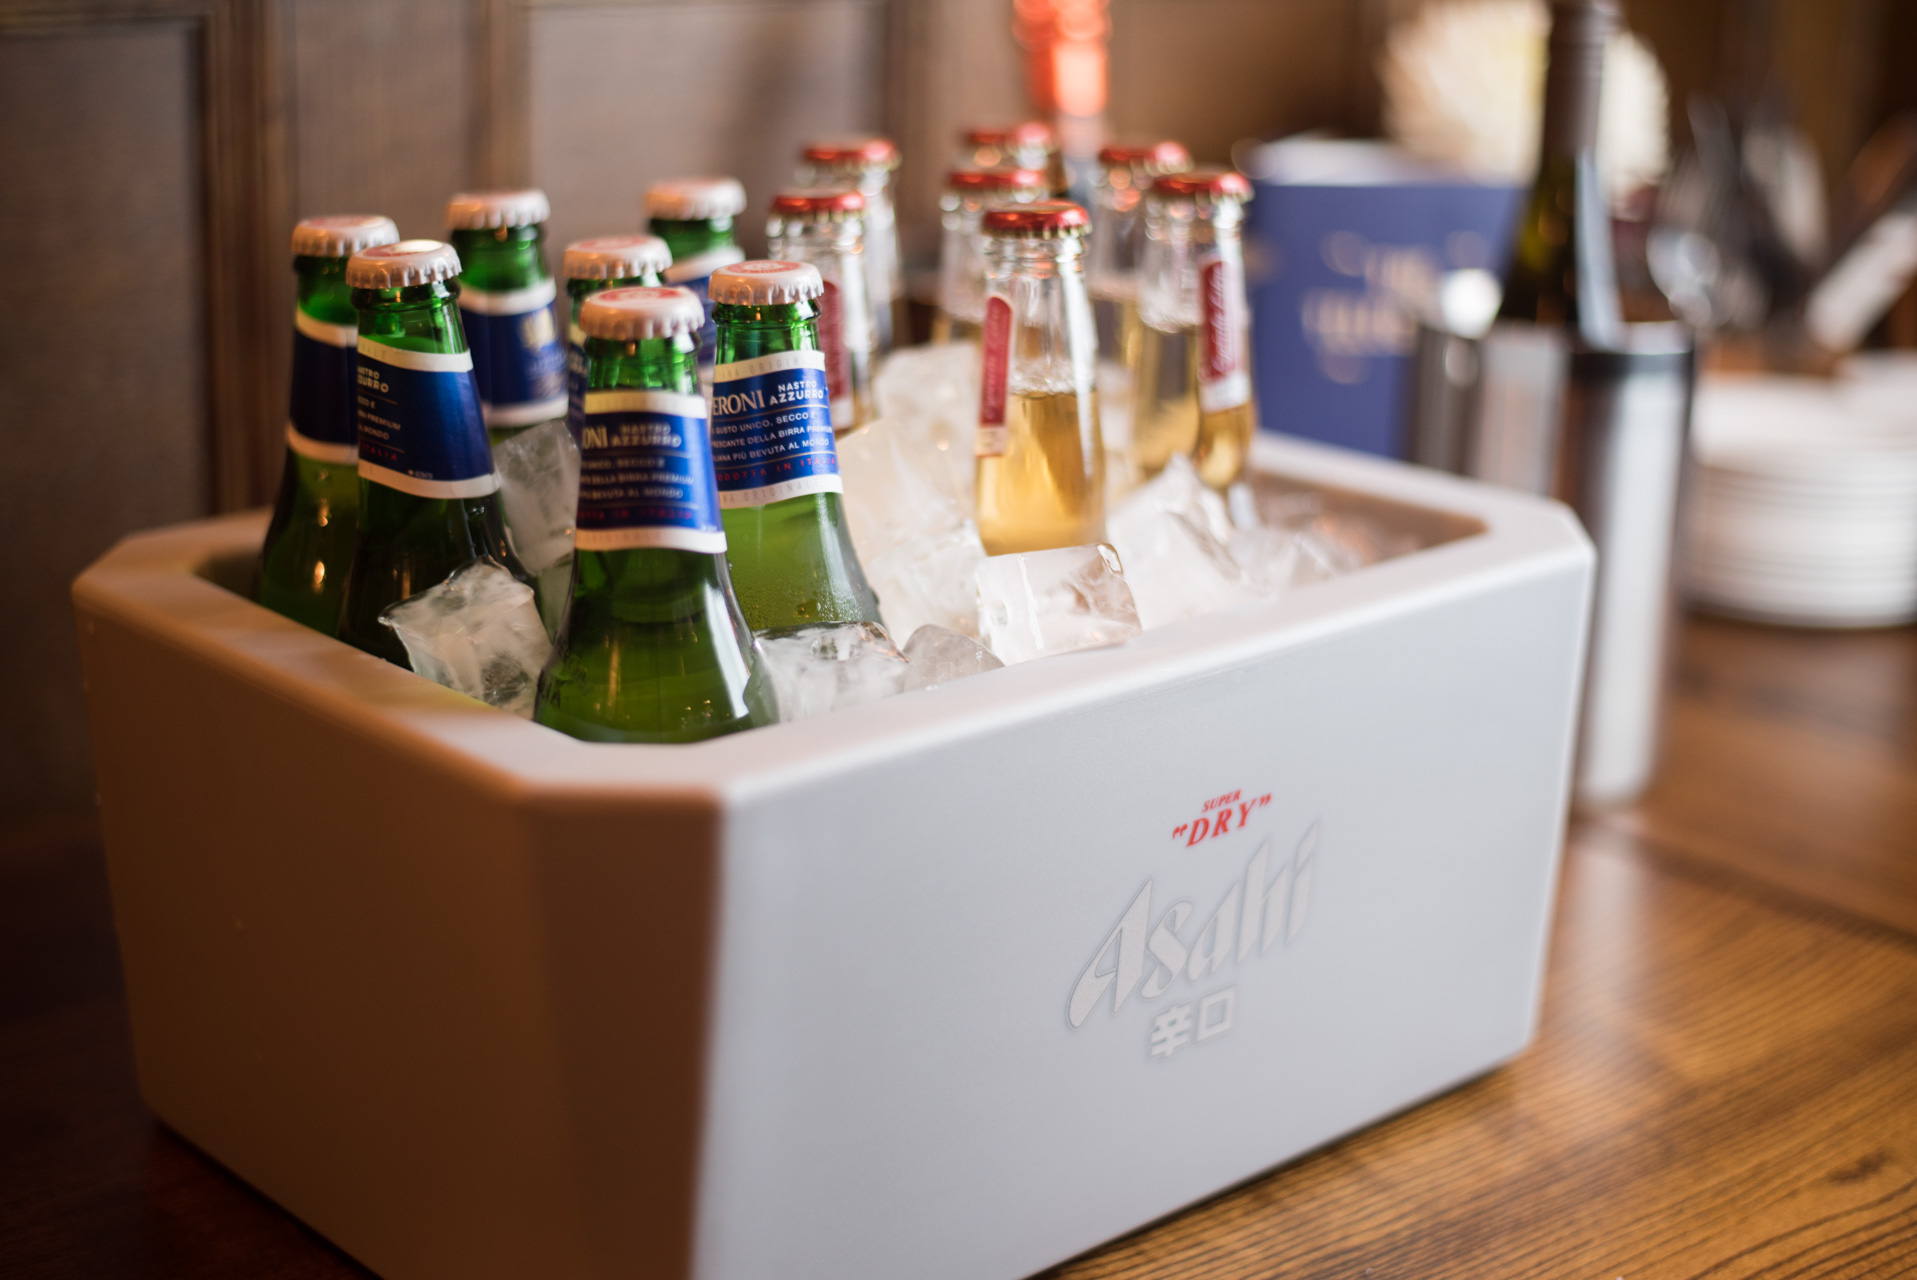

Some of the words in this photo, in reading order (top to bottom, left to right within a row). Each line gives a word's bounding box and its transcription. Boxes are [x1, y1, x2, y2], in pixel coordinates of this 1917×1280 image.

[769, 384, 824, 406] AZZURRO
[778, 380, 817, 392] NASTRO
[712, 389, 766, 416] ERONI
[776, 412, 809, 424] SECCO
[810, 411, 816, 419] E
[582, 426, 608, 449] ONI
[747, 433, 776, 444] DELLA
[778, 427, 805, 438] BIRRA
[749, 445, 786, 458] BEVUTA
[788, 442, 800, 450] AL
[802, 438, 829, 447] MONDO
[776, 463, 791, 473] IN
[800, 458, 835, 467] ITALIA
[1202, 789, 1241, 813] SUPER
[1066, 816, 1320, 1030] Asahi
[1149, 982, 1239, 1060] 辛口
